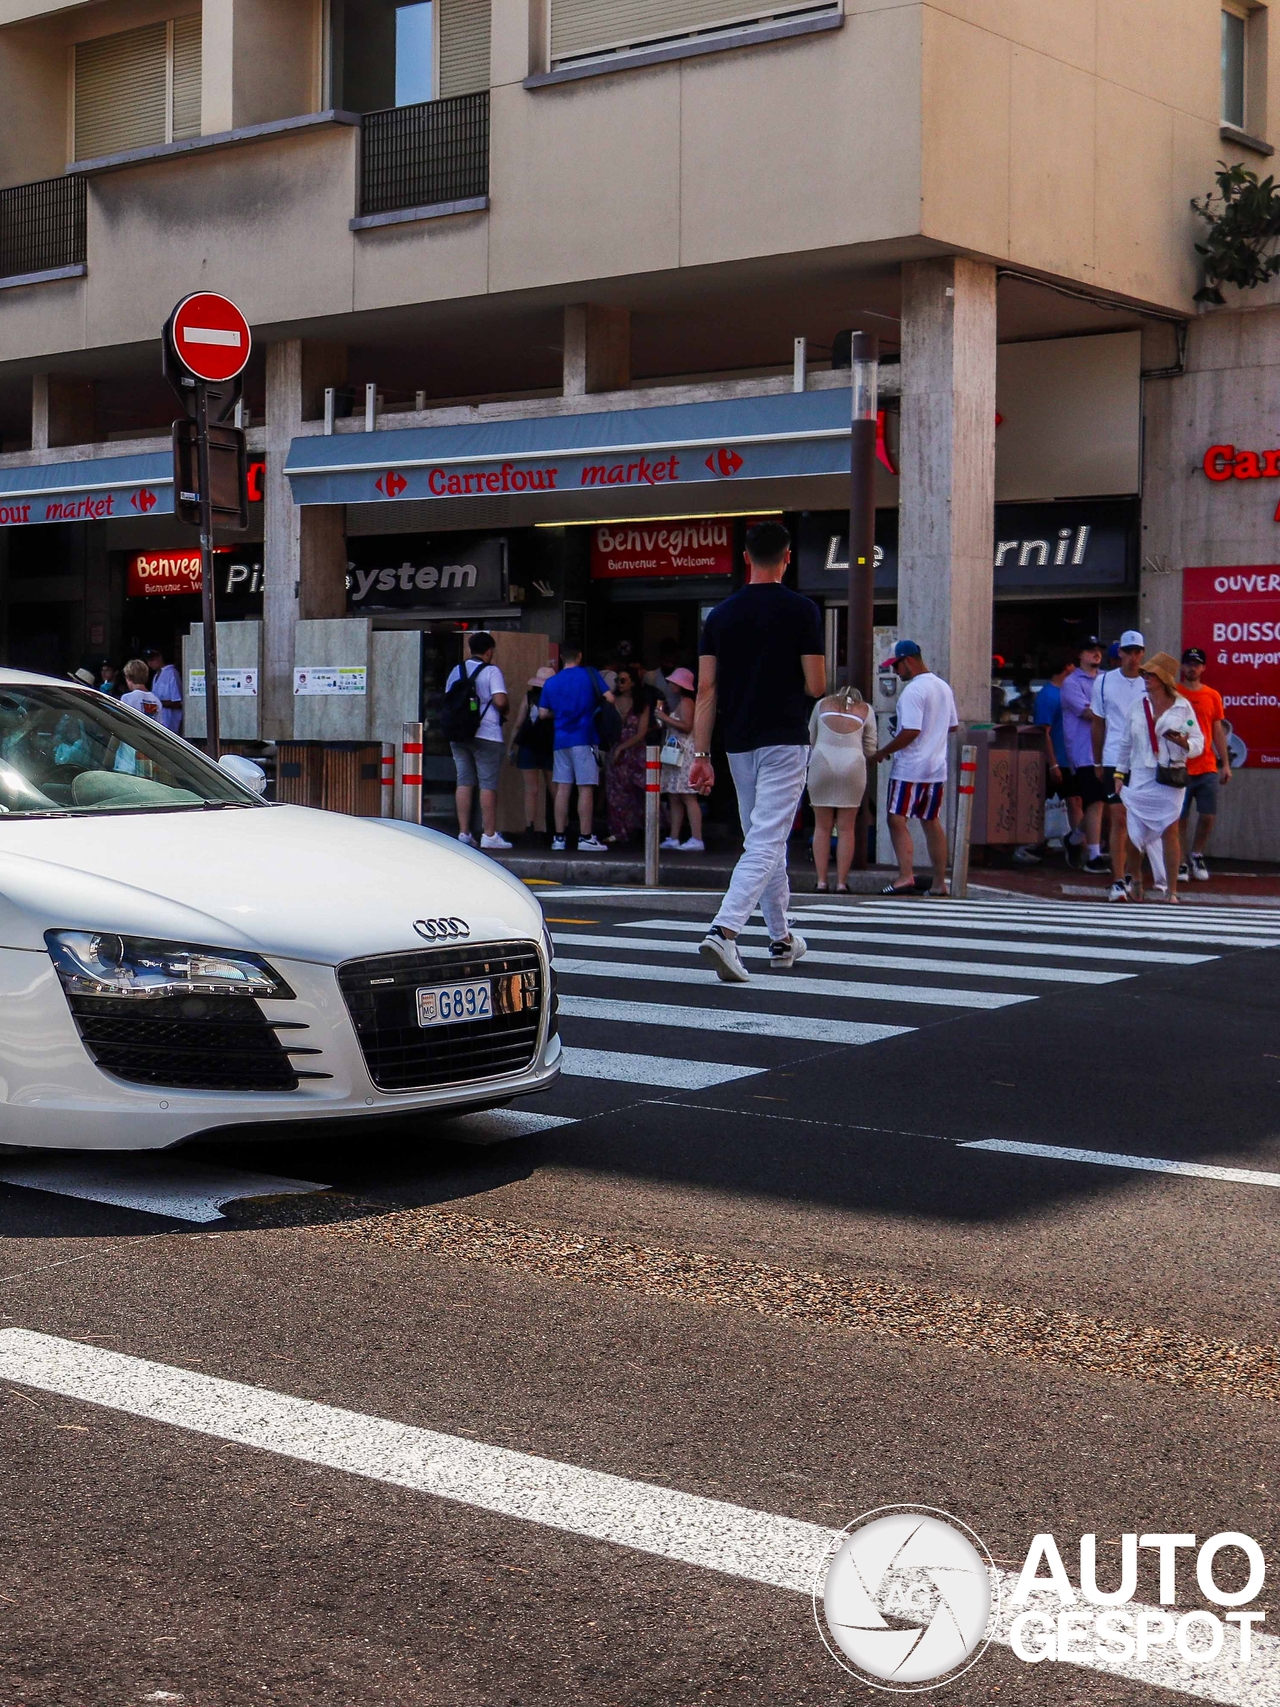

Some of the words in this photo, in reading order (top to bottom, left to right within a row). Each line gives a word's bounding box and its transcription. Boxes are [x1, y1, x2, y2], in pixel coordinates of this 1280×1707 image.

[428, 462, 558, 497] Carrefour
[581, 455, 680, 485] market
[45, 494, 115, 520] market
[994, 525, 1091, 567] rnil
[136, 556, 202, 580] Benveg
[607, 559, 657, 571] Bienvenue
[671, 556, 716, 567] Welcome
[144, 582, 181, 593] Bienvenue
[225, 563, 265, 593] Pi
[1217, 649, 1228, 664] à
[1222, 692, 1280, 709] puccino,
[423, 1005, 435, 1015] MC
[439, 986, 489, 1019] G892
